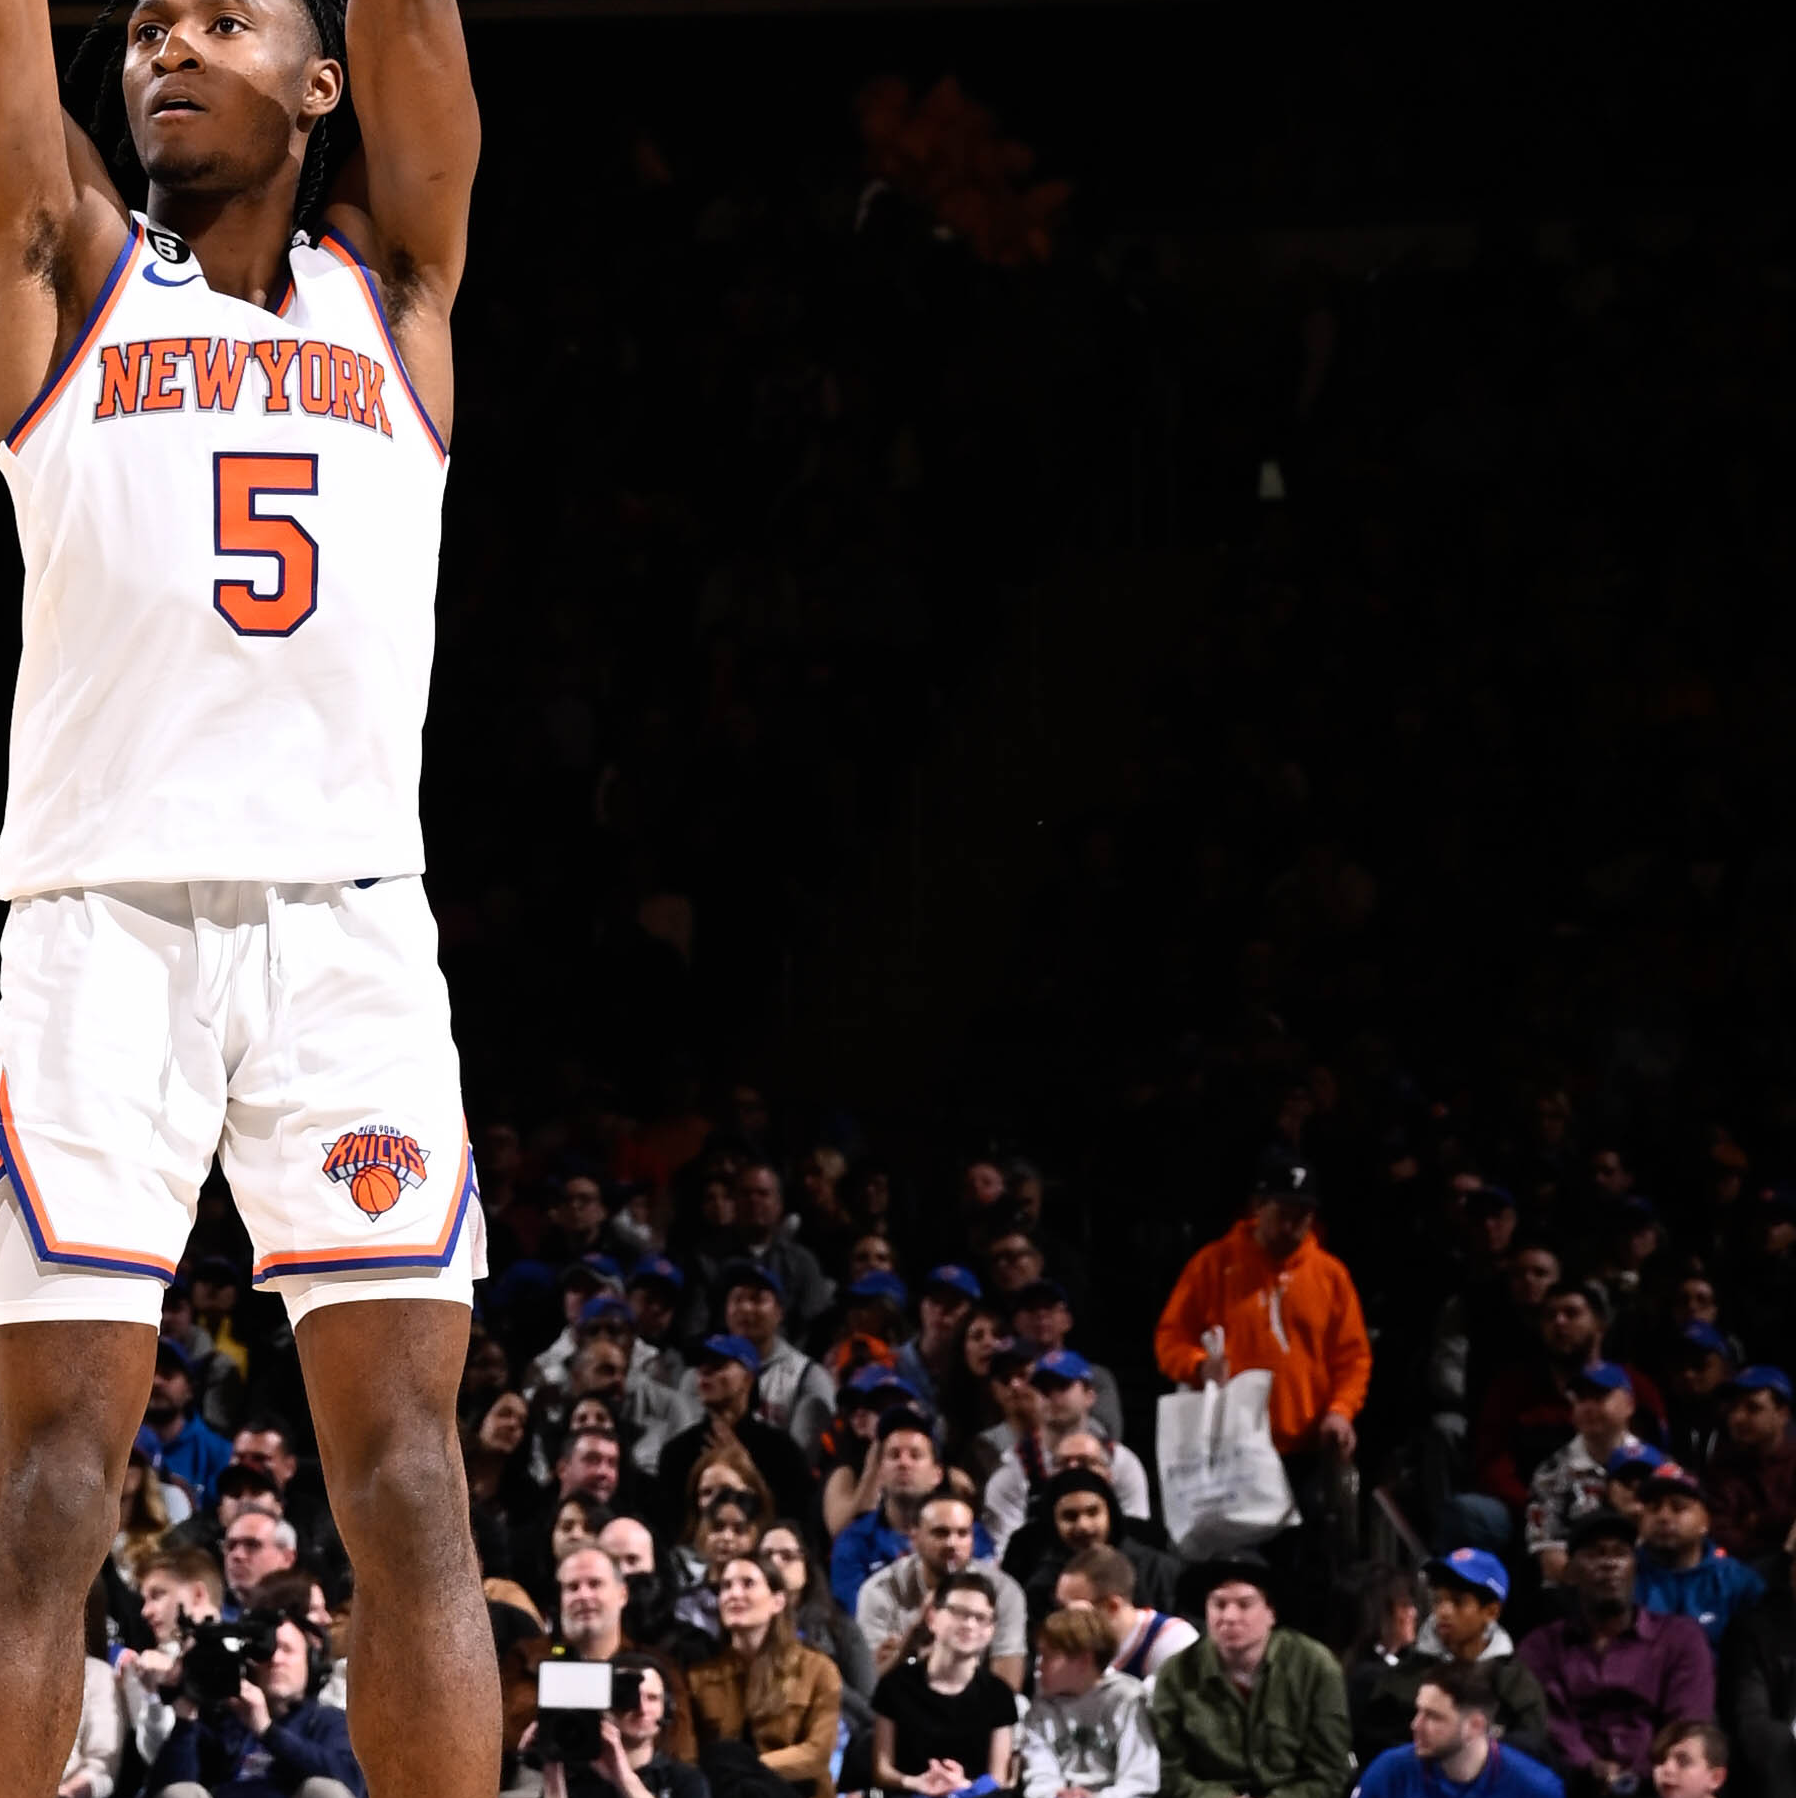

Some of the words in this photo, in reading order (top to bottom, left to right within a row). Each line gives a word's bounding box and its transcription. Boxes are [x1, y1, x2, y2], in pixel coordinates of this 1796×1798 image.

[92, 336, 251, 424] NEW
[251, 338, 395, 443] YORK
[212, 451, 319, 638] 5
[321, 1131, 427, 1181] KNICKS
